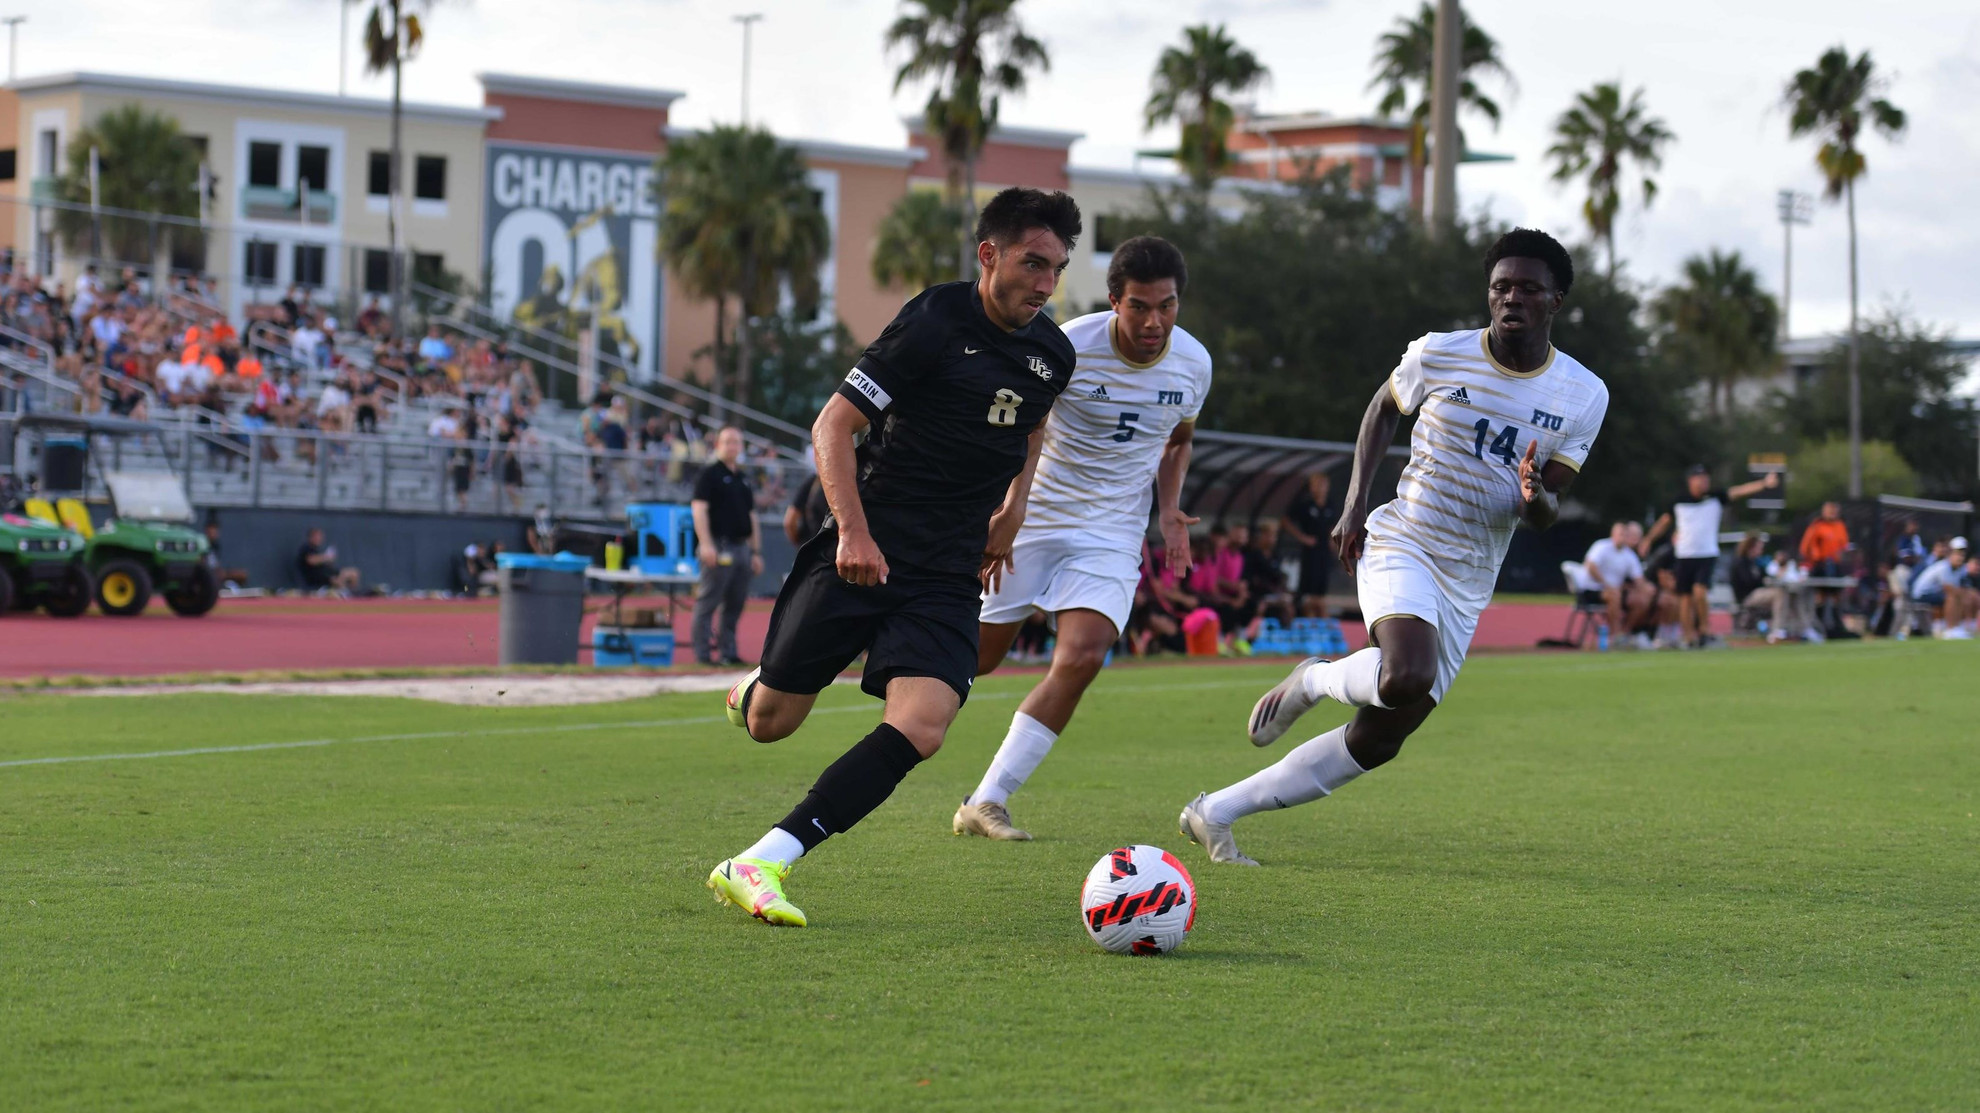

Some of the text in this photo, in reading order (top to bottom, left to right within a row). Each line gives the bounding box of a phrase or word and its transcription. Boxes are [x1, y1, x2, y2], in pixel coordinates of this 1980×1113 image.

[493, 153, 660, 217] CHARGE
[987, 387, 1024, 427] 8
[1157, 390, 1183, 405] FIU
[1447, 395, 1471, 405] adidas
[1112, 412, 1139, 442] 5
[1531, 409, 1564, 431] FIU
[1474, 418, 1519, 466] 14
